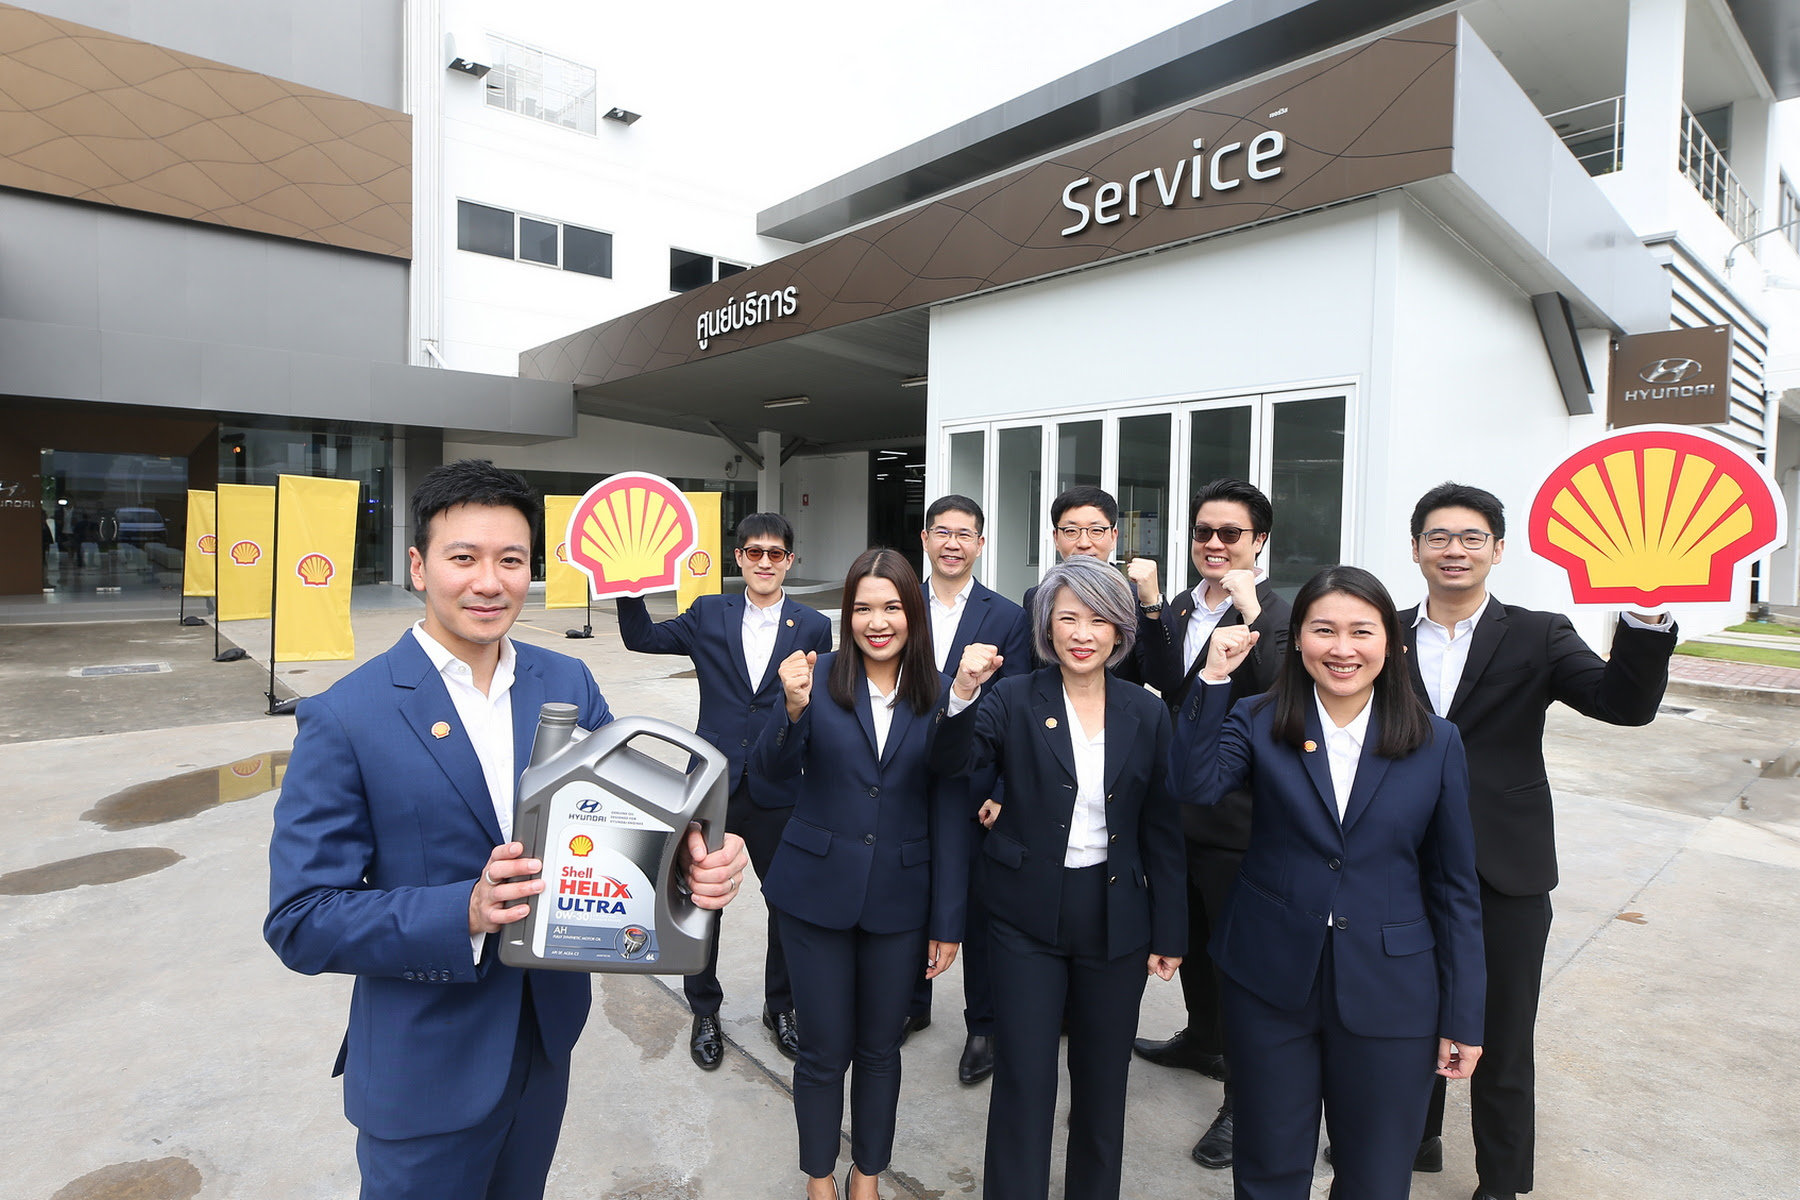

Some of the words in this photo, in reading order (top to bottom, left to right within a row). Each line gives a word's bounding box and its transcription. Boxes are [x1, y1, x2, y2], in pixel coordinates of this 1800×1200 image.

[1061, 130, 1286, 237] Service
[697, 285, 797, 350] ศูนย์บริการ
[1625, 384, 1715, 401] HYUNDAI
[568, 813, 607, 822] HYUNDAI
[561, 866, 593, 879] Shell
[559, 879, 630, 899] HELIX
[557, 897, 627, 914] ULTRA
[555, 911, 590, 921] 0W-30
[553, 926, 568, 934] AH
[646, 953, 655, 961] 6L
